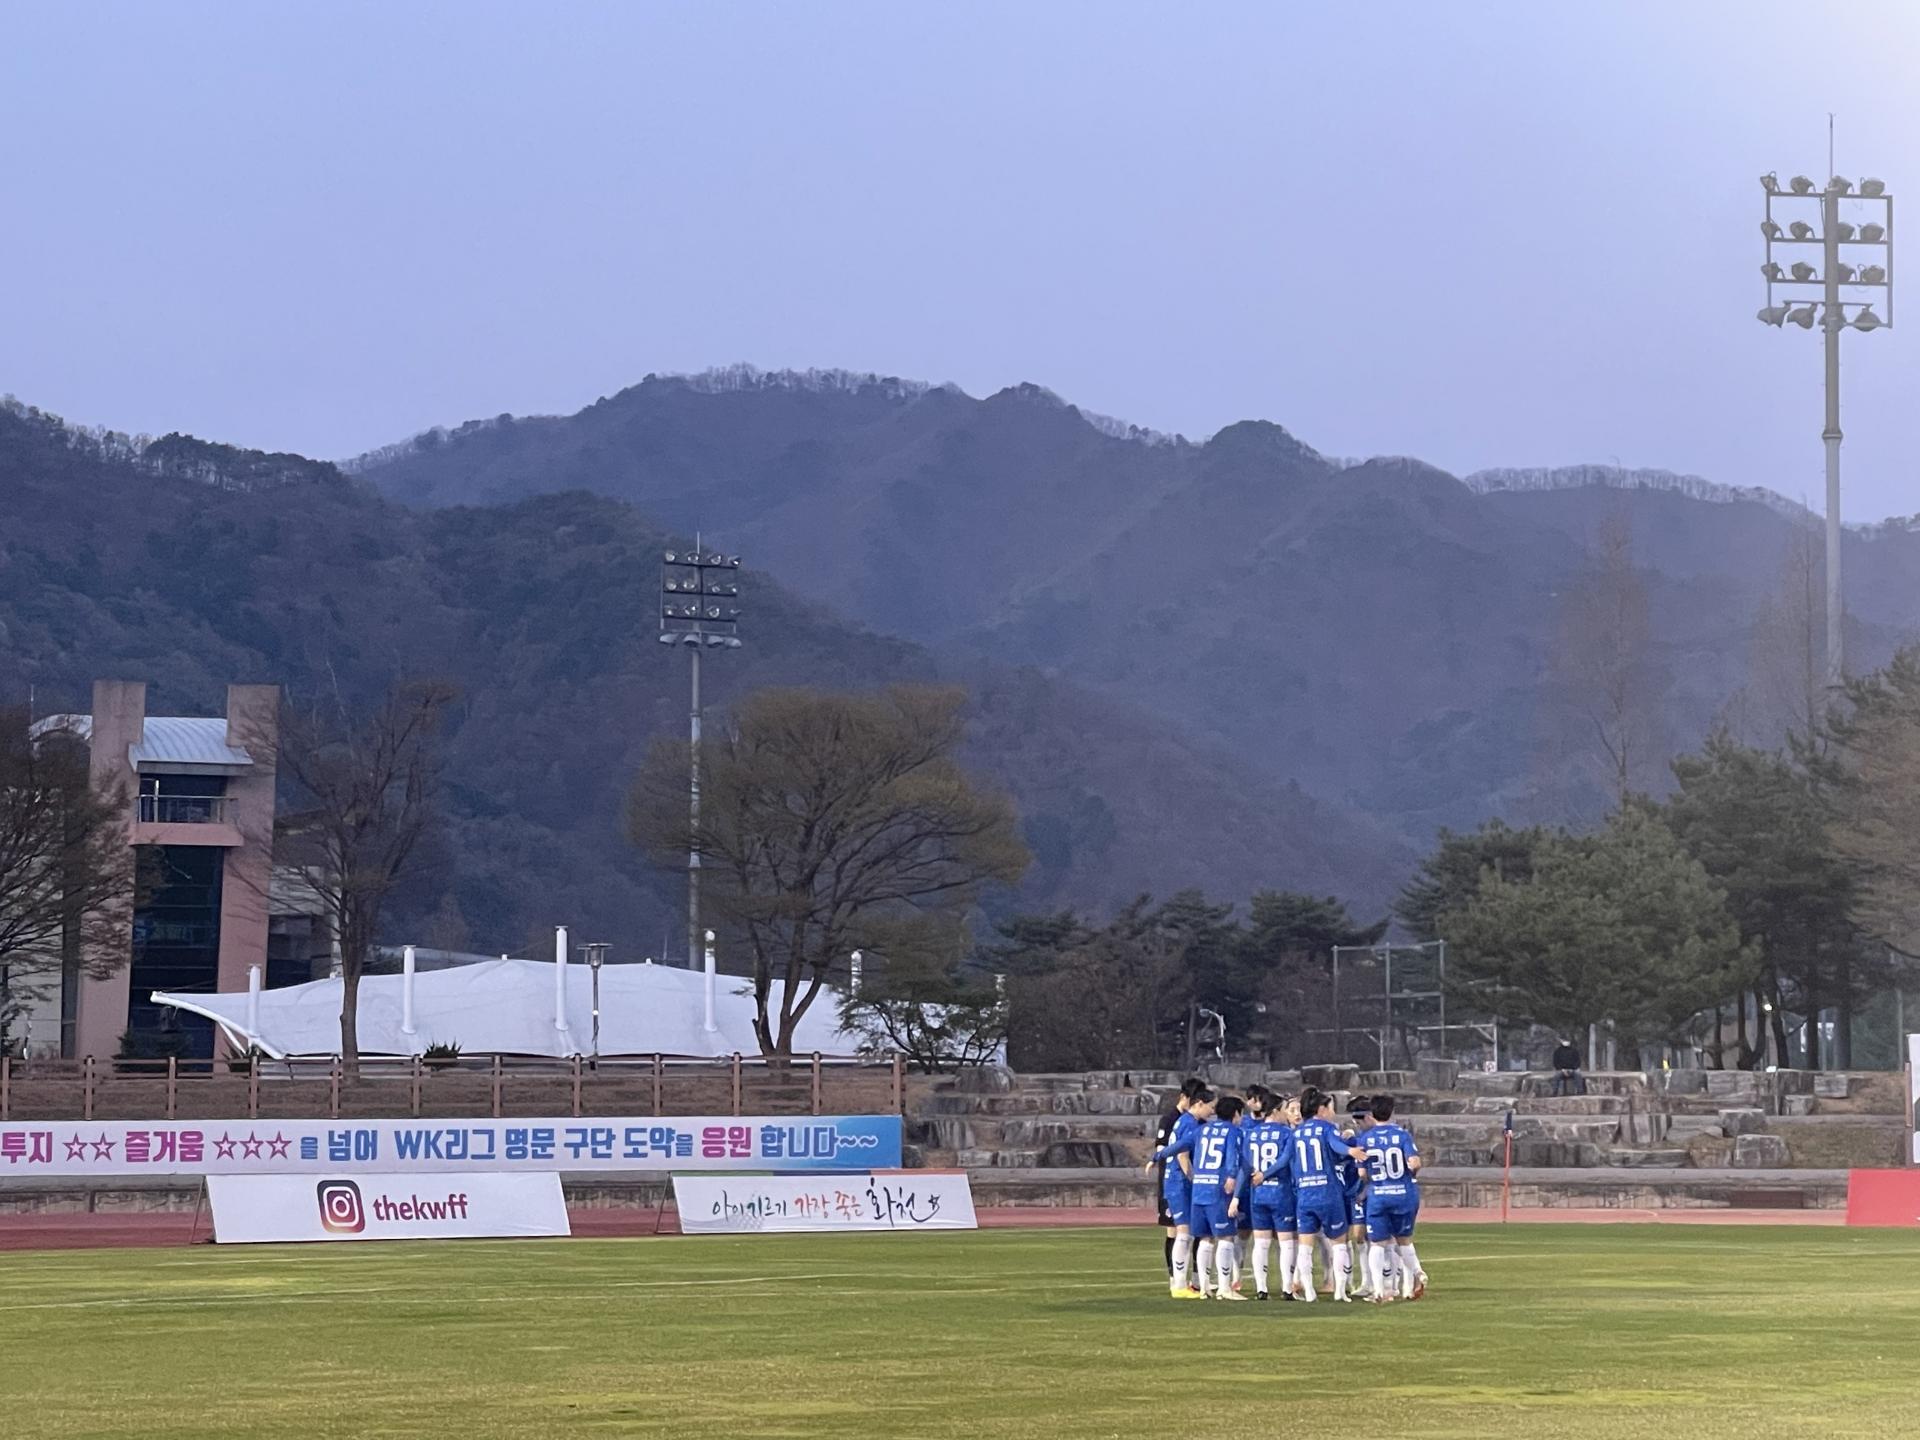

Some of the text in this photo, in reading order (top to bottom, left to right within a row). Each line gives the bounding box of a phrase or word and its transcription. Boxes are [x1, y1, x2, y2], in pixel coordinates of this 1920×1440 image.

[1, 1132, 53, 1163] 투지
[125, 1131, 205, 1163] 즐거움
[301, 1137, 318, 1160] 을
[329, 1129, 377, 1162] 넘어
[395, 1129, 496, 1161] WK리그
[505, 1127, 555, 1159] 명문
[564, 1127, 615, 1159] 구단
[702, 1126, 752, 1158] 응원
[1199, 1138, 1225, 1170] 15
[1250, 1142, 1278, 1173] 18
[1296, 1138, 1323, 1172] 11
[1366, 1147, 1403, 1182] 30
[373, 1193, 468, 1220] thekwff
[794, 1193, 830, 1219] 가장
[866, 1177, 940, 1227] 화천
